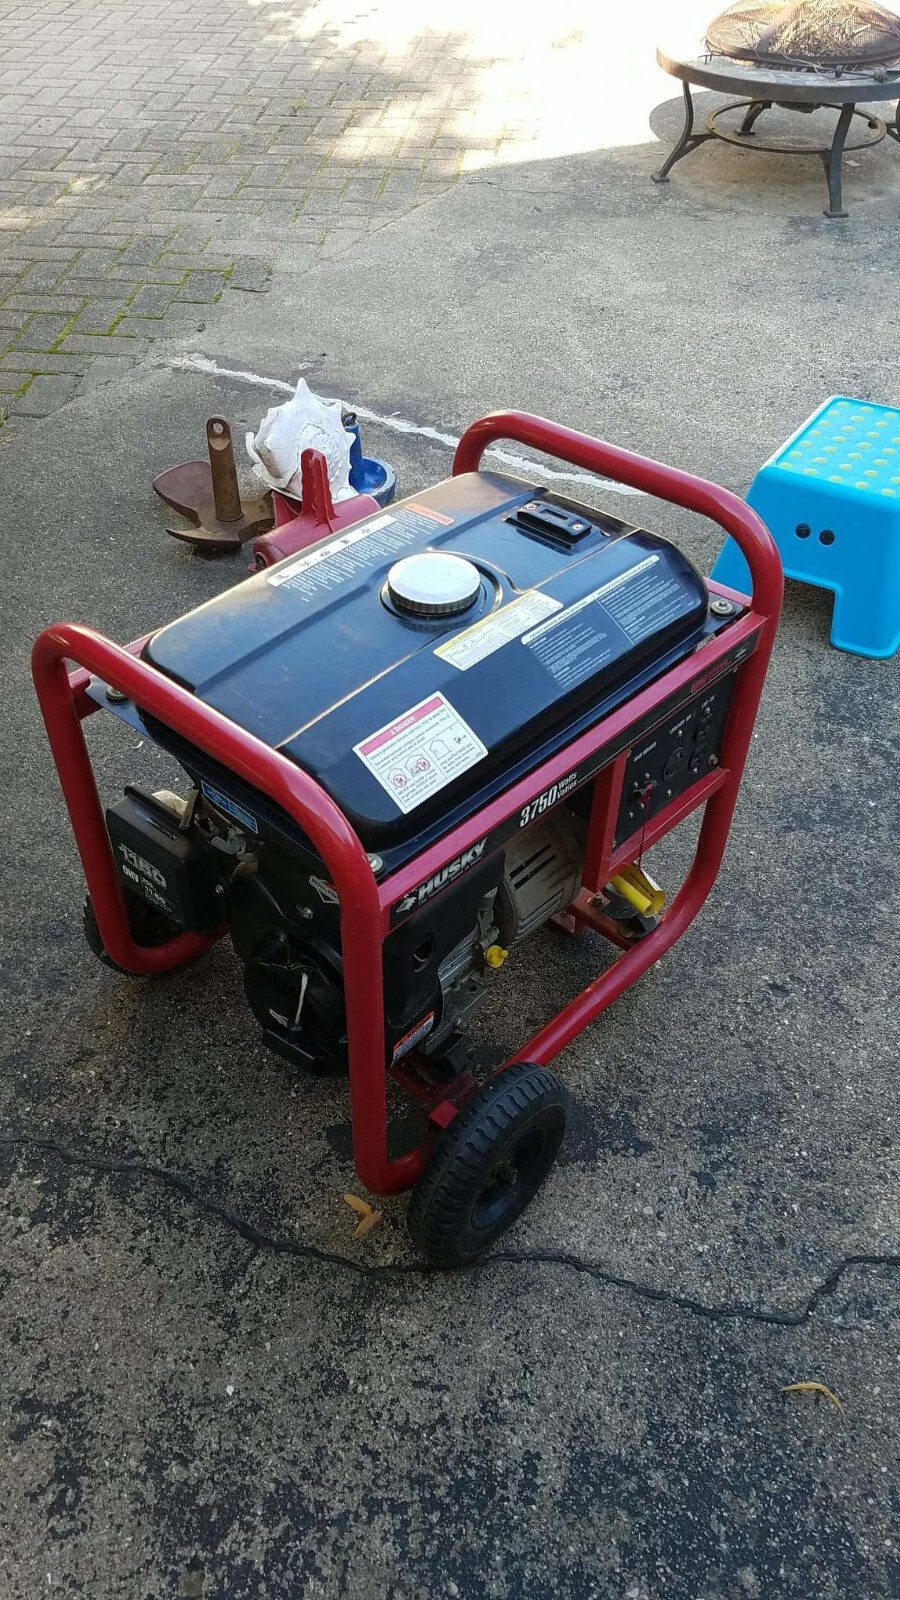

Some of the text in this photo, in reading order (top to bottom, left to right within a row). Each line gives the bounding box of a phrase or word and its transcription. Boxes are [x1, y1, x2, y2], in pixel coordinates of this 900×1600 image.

[393, 715, 416, 732] DANGER
[558, 772, 578, 788] Watts
[520, 785, 558, 828] 3750
[418, 837, 488, 900] HUSKY
